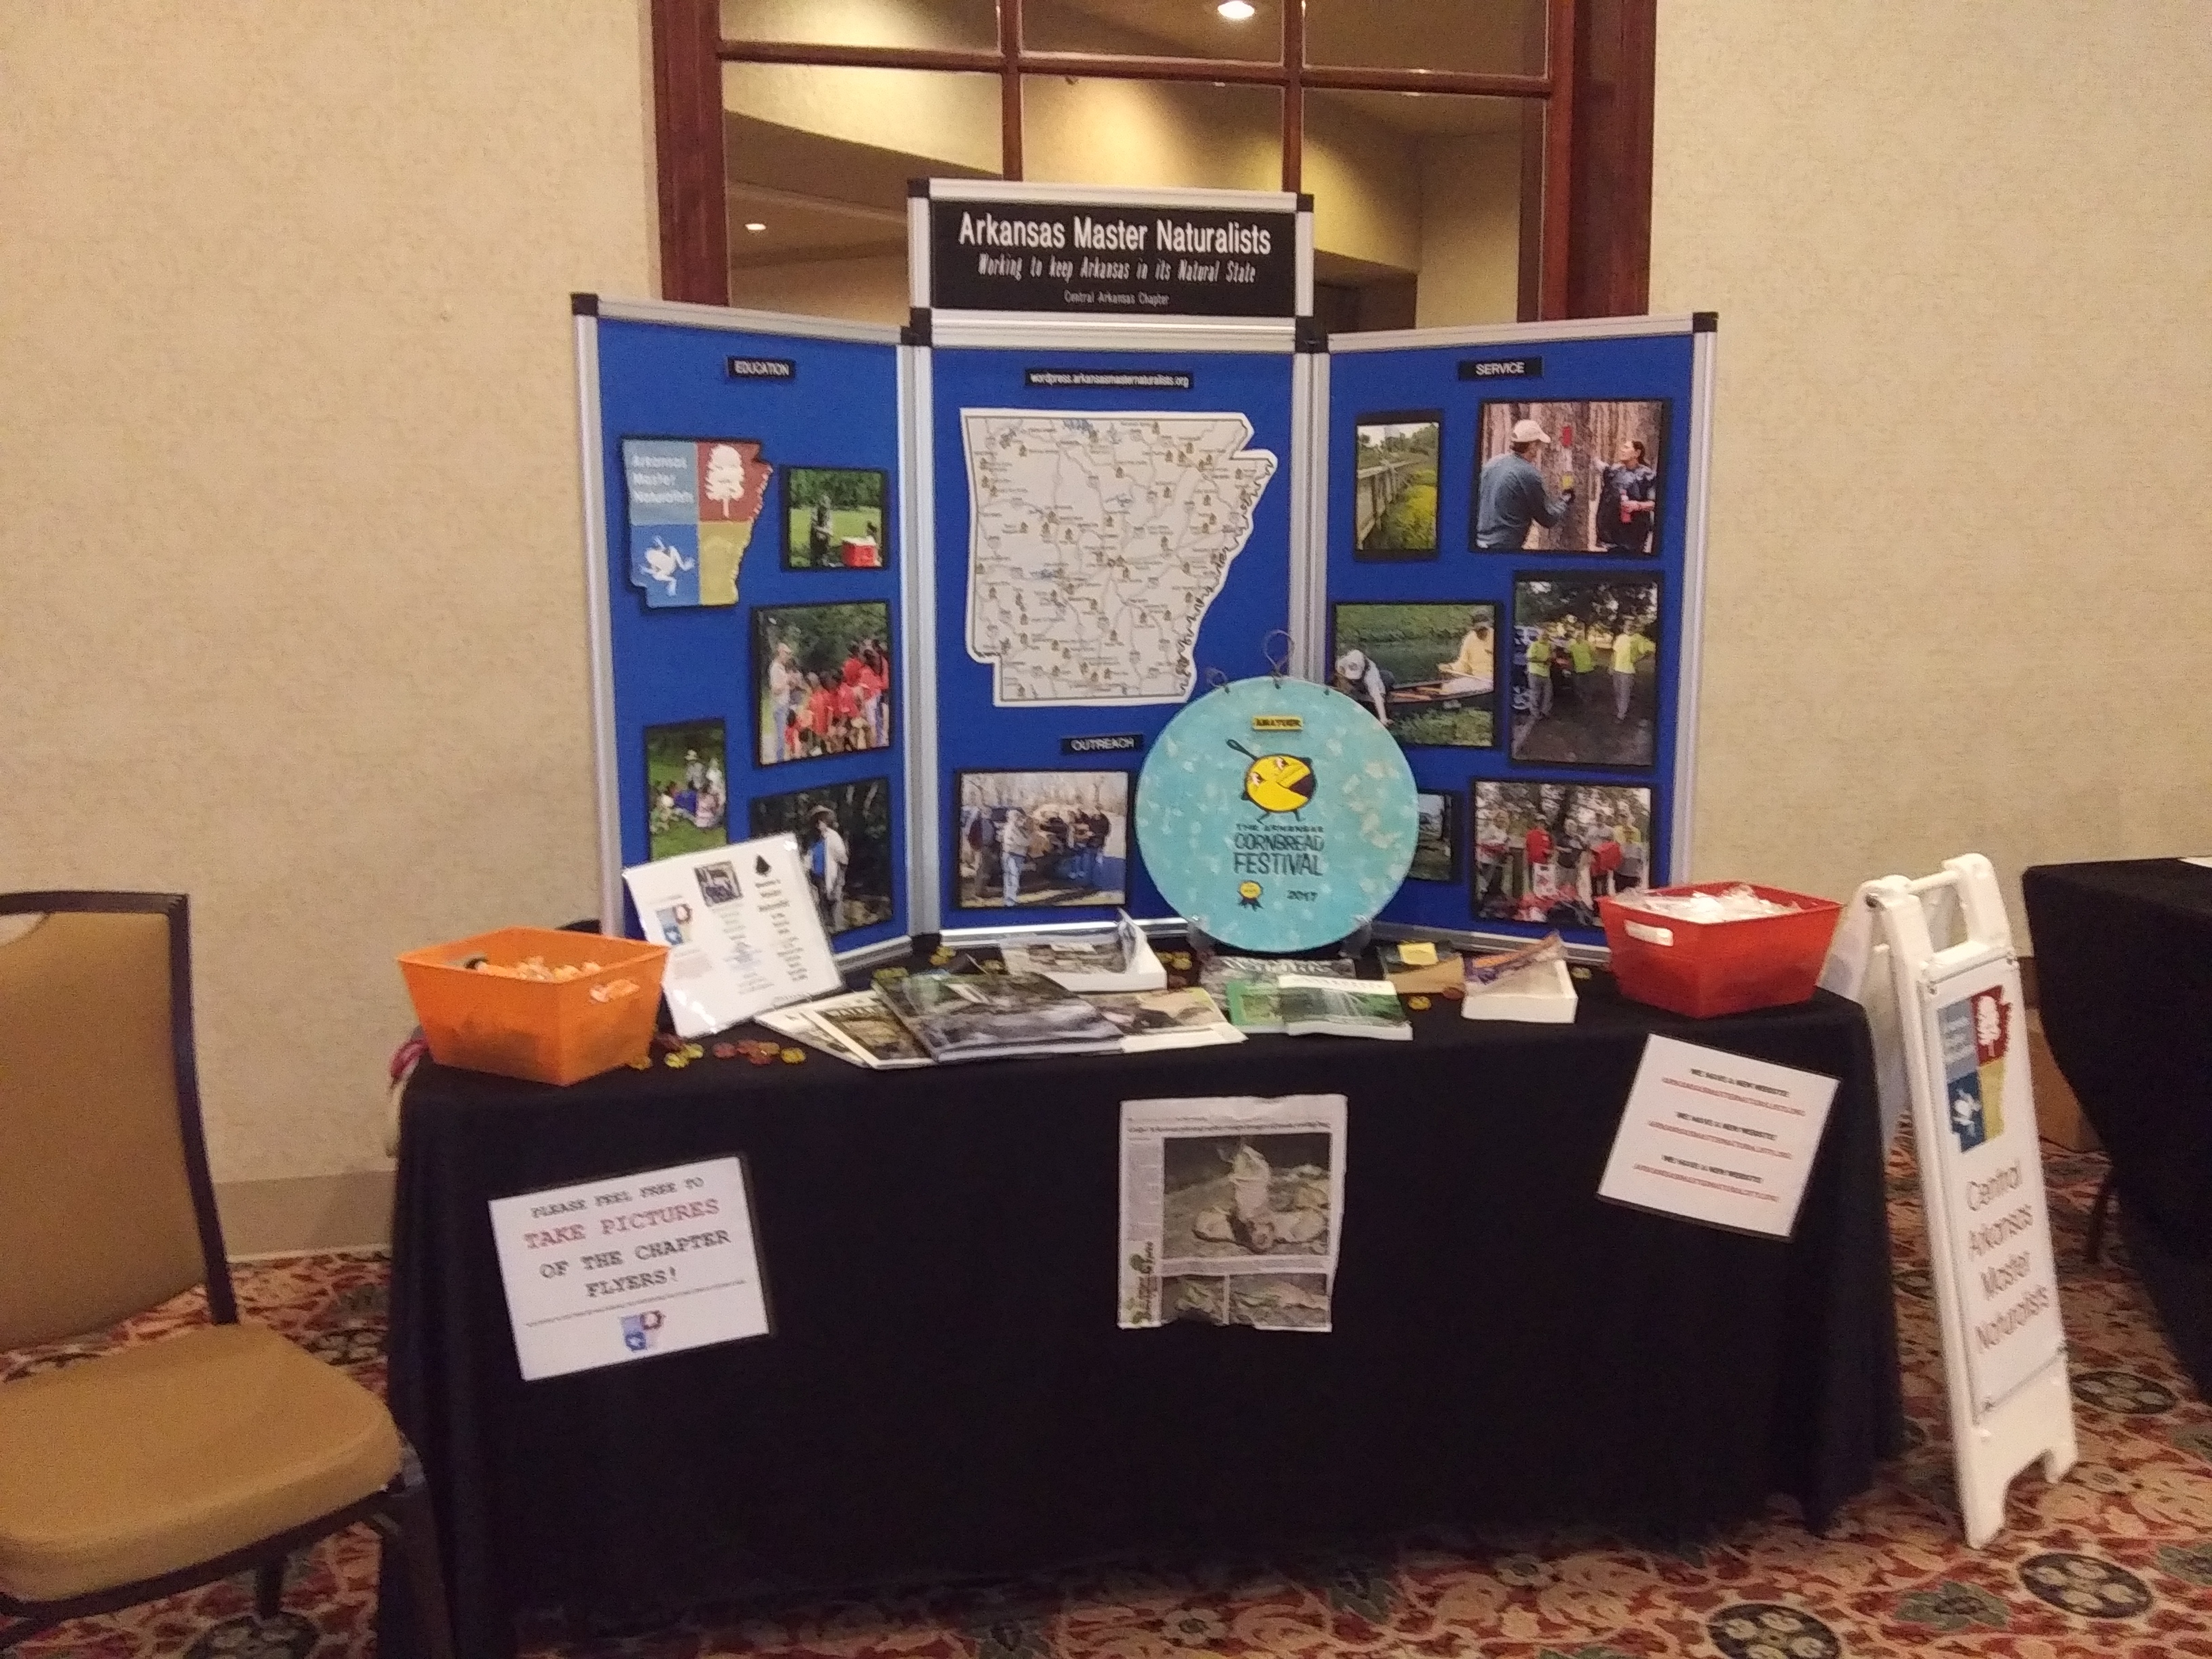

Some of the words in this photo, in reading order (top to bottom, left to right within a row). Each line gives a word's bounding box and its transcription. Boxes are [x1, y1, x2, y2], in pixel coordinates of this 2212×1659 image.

[958, 211, 1066, 249] Arkansas
[1073, 215, 1148, 251] Master
[1157, 218, 1271, 255] Naturalists
[978, 252, 1023, 281] Working
[1030, 255, 1043, 278] to
[1049, 254, 1074, 284] keep
[1080, 255, 1130, 281] Arkansas
[1136, 258, 1148, 280] in
[1154, 258, 1172, 281] its
[1177, 259, 1221, 283] Natural
[1225, 260, 1256, 283] State
[1063, 289, 1095, 304] Central
[1097, 291, 1136, 304] Arkansas
[1138, 291, 1170, 307] Chapter
[733, 359, 790, 376] EDUCATION
[1475, 361, 1525, 376] SERVICE
[1071, 737, 1134, 751] OUTREACH
[1234, 832, 1325, 852] CORNBREAD
[1232, 852, 1324, 877] FESTIVAL
[1287, 889, 1318, 902] 2017
[531, 1198, 588, 1218] PLEASE
[594, 1191, 633, 1207] FEEL
[640, 1181, 677, 1199] FREE
[684, 1176, 705, 1189] TO
[1965, 1157, 2022, 1212] Central
[523, 1223, 587, 1250] TAKE
[600, 1197, 720, 1235] PICTURES
[1967, 1203, 2032, 1261] Arkansas
[539, 1260, 570, 1279] OF
[580, 1250, 624, 1271] THE
[634, 1229, 732, 1261] CHAPTER
[585, 1265, 678, 1298] FLYERS!
[1980, 1250, 2030, 1301] Master
[1975, 1284, 2049, 1355] Naturalists
